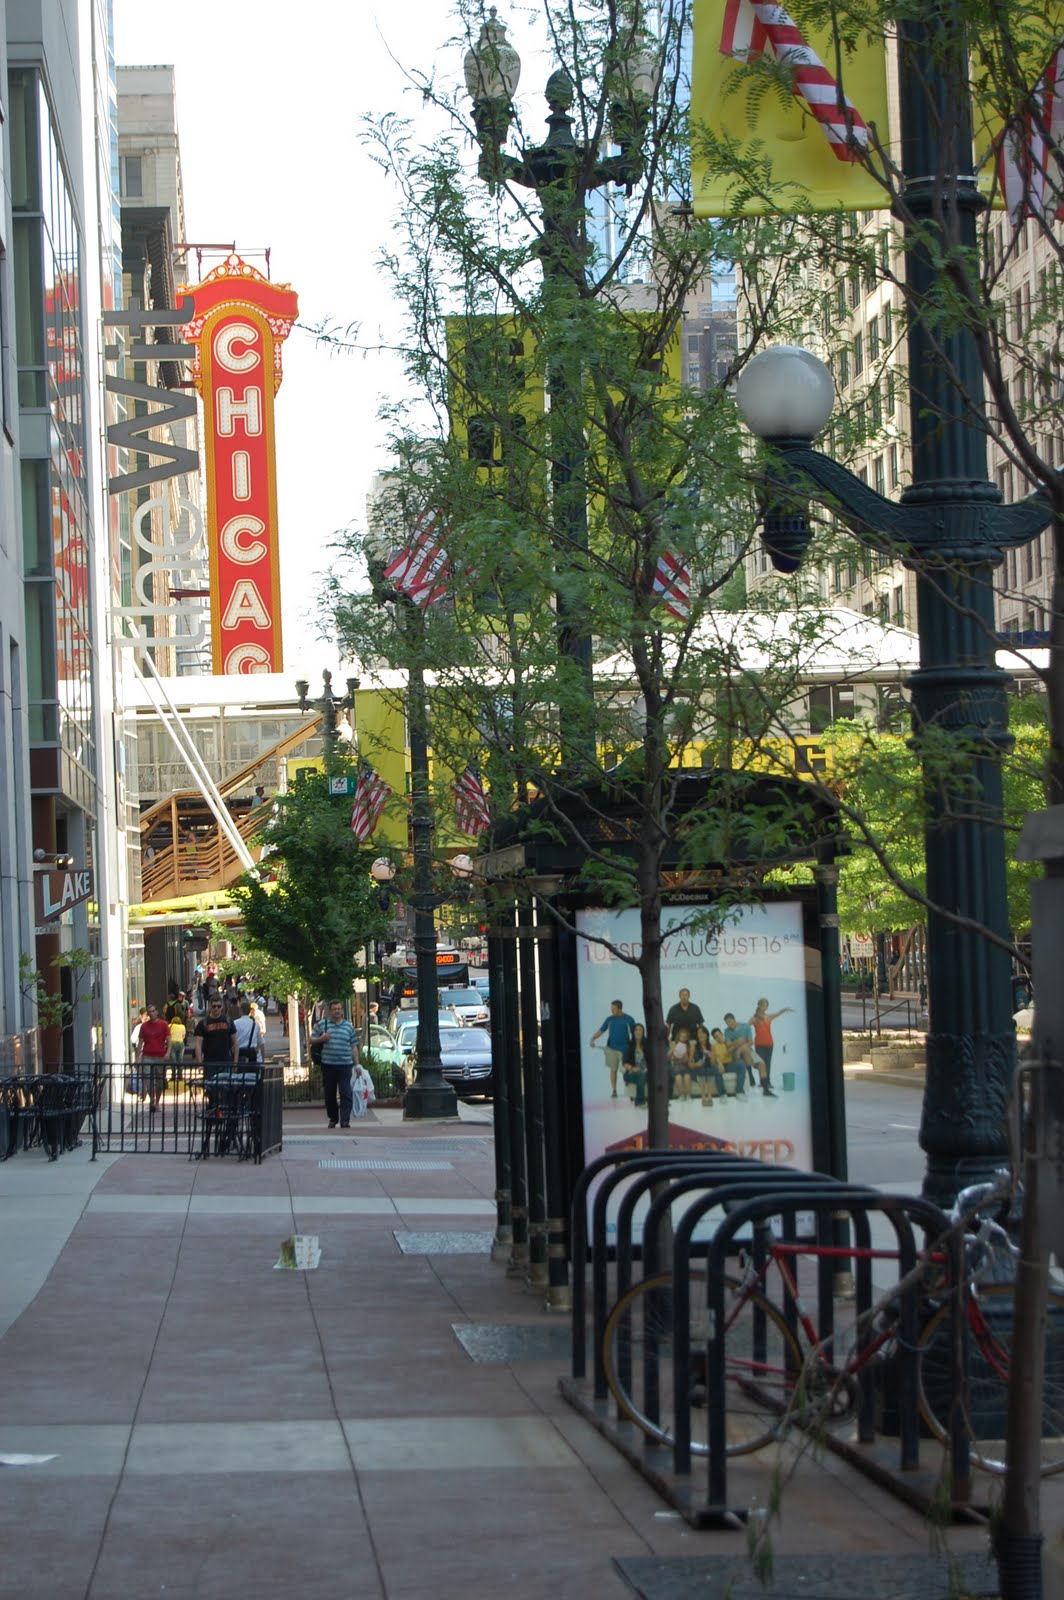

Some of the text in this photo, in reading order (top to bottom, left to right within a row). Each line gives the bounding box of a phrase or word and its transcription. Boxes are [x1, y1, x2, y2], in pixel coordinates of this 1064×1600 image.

[42, 872, 90, 917] LAKE
[583, 941, 672, 962] TUESDY
[674, 937, 759, 958] AUGUST
[762, 936, 782, 953] 16
